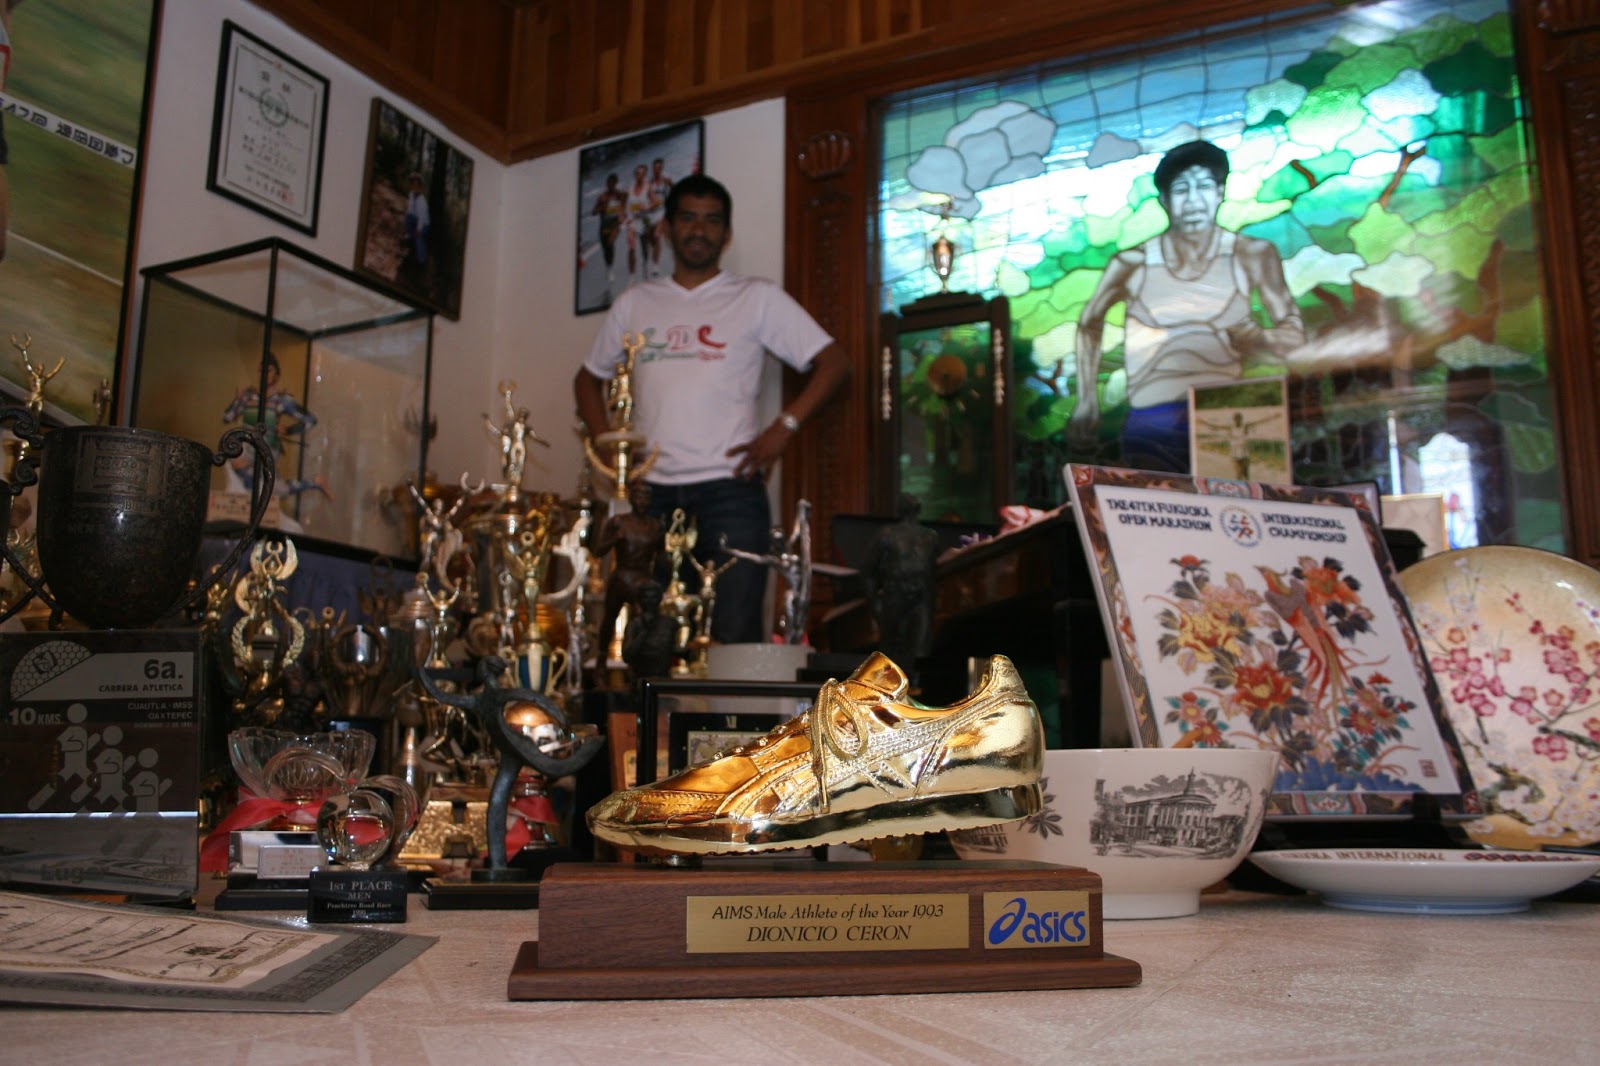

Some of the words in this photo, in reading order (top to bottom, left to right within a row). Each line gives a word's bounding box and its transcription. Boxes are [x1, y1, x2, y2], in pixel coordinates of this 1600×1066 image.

[1157, 502, 1212, 517] FUKUOKA
[1118, 513, 1147, 525] OPEN
[1150, 516, 1212, 531] MARATHON
[142, 684, 183, 692] ATLETICA
[9, 708, 36, 726] 10
[148, 711, 193, 720] OAXTEPEC
[1337, 851, 1446, 861] INTERNATIONAL
[351, 881, 392, 891] PLACE
[348, 891, 372, 899] MEN
[712, 905, 753, 919] AIMS
[755, 904, 787, 919] Male
[790, 904, 838, 919] Athlete
[841, 903, 857, 921] of
[859, 903, 879, 918] the
[881, 904, 909, 918] Year
[912, 904, 944, 919] 1993
[746, 925, 838, 942] DIONICIO
[846, 925, 912, 941] CERON
